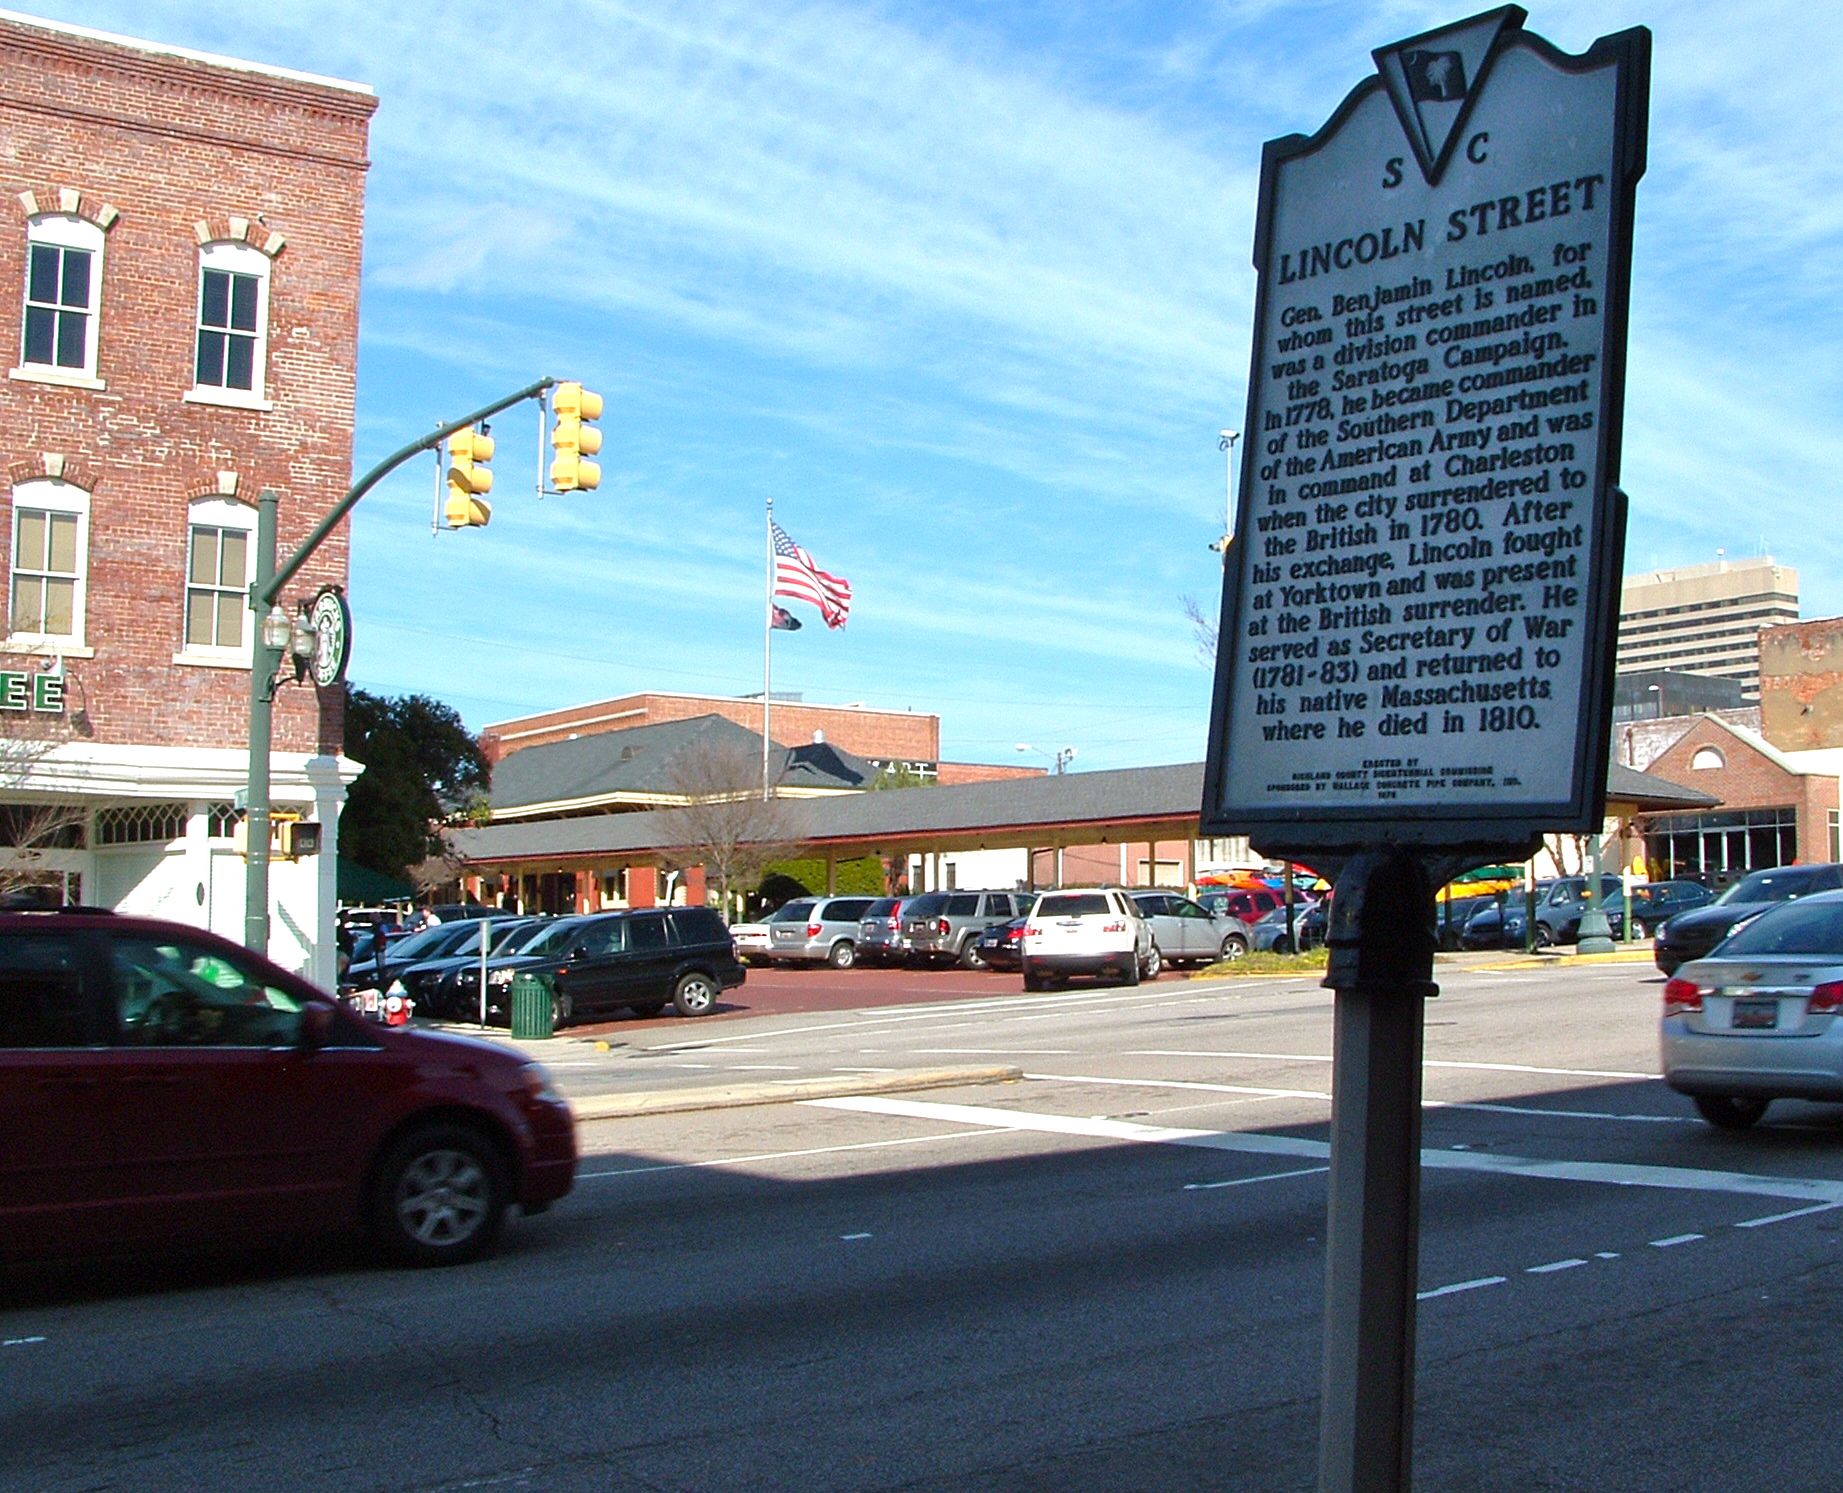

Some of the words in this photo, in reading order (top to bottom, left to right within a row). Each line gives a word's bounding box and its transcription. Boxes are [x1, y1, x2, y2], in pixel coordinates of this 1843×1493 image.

[1382, 157, 1404, 189] S
[1466, 131, 1489, 164] C
[1278, 219, 1426, 285] LINCOLN
[1446, 174, 1605, 242] STREET
[1281, 306, 1322, 328] Gen.
[1332, 276, 1432, 317] Benjamin
[1553, 242, 1592, 267] for
[1272, 358, 1306, 379] was
[1312, 355, 1325, 370] a
[1333, 334, 1416, 365] division
[1425, 303, 1562, 346] commander
[1572, 294, 1597, 318] in
[1277, 327, 1333, 353] whom
[1345, 313, 1384, 338] this
[1396, 294, 1463, 327] street
[1474, 288, 1493, 311] is
[1264, 410, 1281, 431] In
[1285, 397, 1335, 427] 1778,
[1341, 395, 1367, 416] he
[1371, 379, 1454, 410] became
[1458, 353, 1596, 393] commander
[1288, 379, 1320, 401] the
[1332, 358, 1429, 392] Saratoga
[1443, 331, 1568, 369] Campaign.
[1261, 459, 1281, 481] of
[1286, 456, 1316, 477] the
[1319, 438, 1423, 471] American
[1428, 426, 1492, 453] Army
[1497, 414, 1539, 442] and
[1546, 411, 1593, 433] was
[1267, 432, 1288, 455] of
[1297, 428, 1328, 449] the
[1337, 409, 1434, 442] Southern
[1445, 379, 1589, 423] Department
[1257, 510, 1306, 532] when
[1315, 503, 1348, 523] the
[1355, 494, 1398, 519] city
[1405, 469, 1549, 511] surrendered
[1560, 467, 1587, 490] to
[1268, 485, 1286, 505] in
[1298, 465, 1397, 500] command
[1409, 460, 1431, 483] at
[1444, 443, 1575, 478] Charleston
[1252, 562, 1281, 584] his
[1290, 551, 1395, 578] exchange,
[1408, 536, 1492, 566] Lincoln
[1503, 524, 1583, 557] fought
[1264, 536, 1297, 557] the
[1306, 522, 1377, 552] British
[1389, 518, 1410, 541] in
[1420, 506, 1483, 537] 1780.
[1502, 499, 1573, 526] After
[1248, 615, 1268, 637] at
[1278, 612, 1310, 634] the
[1318, 602, 1391, 630] British
[1403, 591, 1526, 622] surrender.
[1542, 585, 1579, 609] He
[1253, 589, 1273, 610] at
[1280, 581, 1381, 608] Yorktown
[1386, 570, 1426, 596] and
[1434, 569, 1475, 590] was
[1482, 554, 1577, 591] present
[1248, 636, 1318, 662] served
[1327, 638, 1351, 656] as
[1359, 625, 1475, 654] Secretary
[1486, 617, 1512, 642] of
[1523, 615, 1573, 640] War
[1367, 656, 1407, 681] and
[1416, 646, 1522, 677] returned
[1535, 646, 1561, 668] to
[0, 671, 63, 712] EE
[1256, 693, 1286, 715] his
[1299, 688, 1367, 713] native
[1263, 720, 1326, 741] where
[1337, 716, 1365, 738] he
[1378, 712, 1427, 736] died
[1442, 709, 1464, 733] in
[1479, 704, 1540, 732] 1810.
